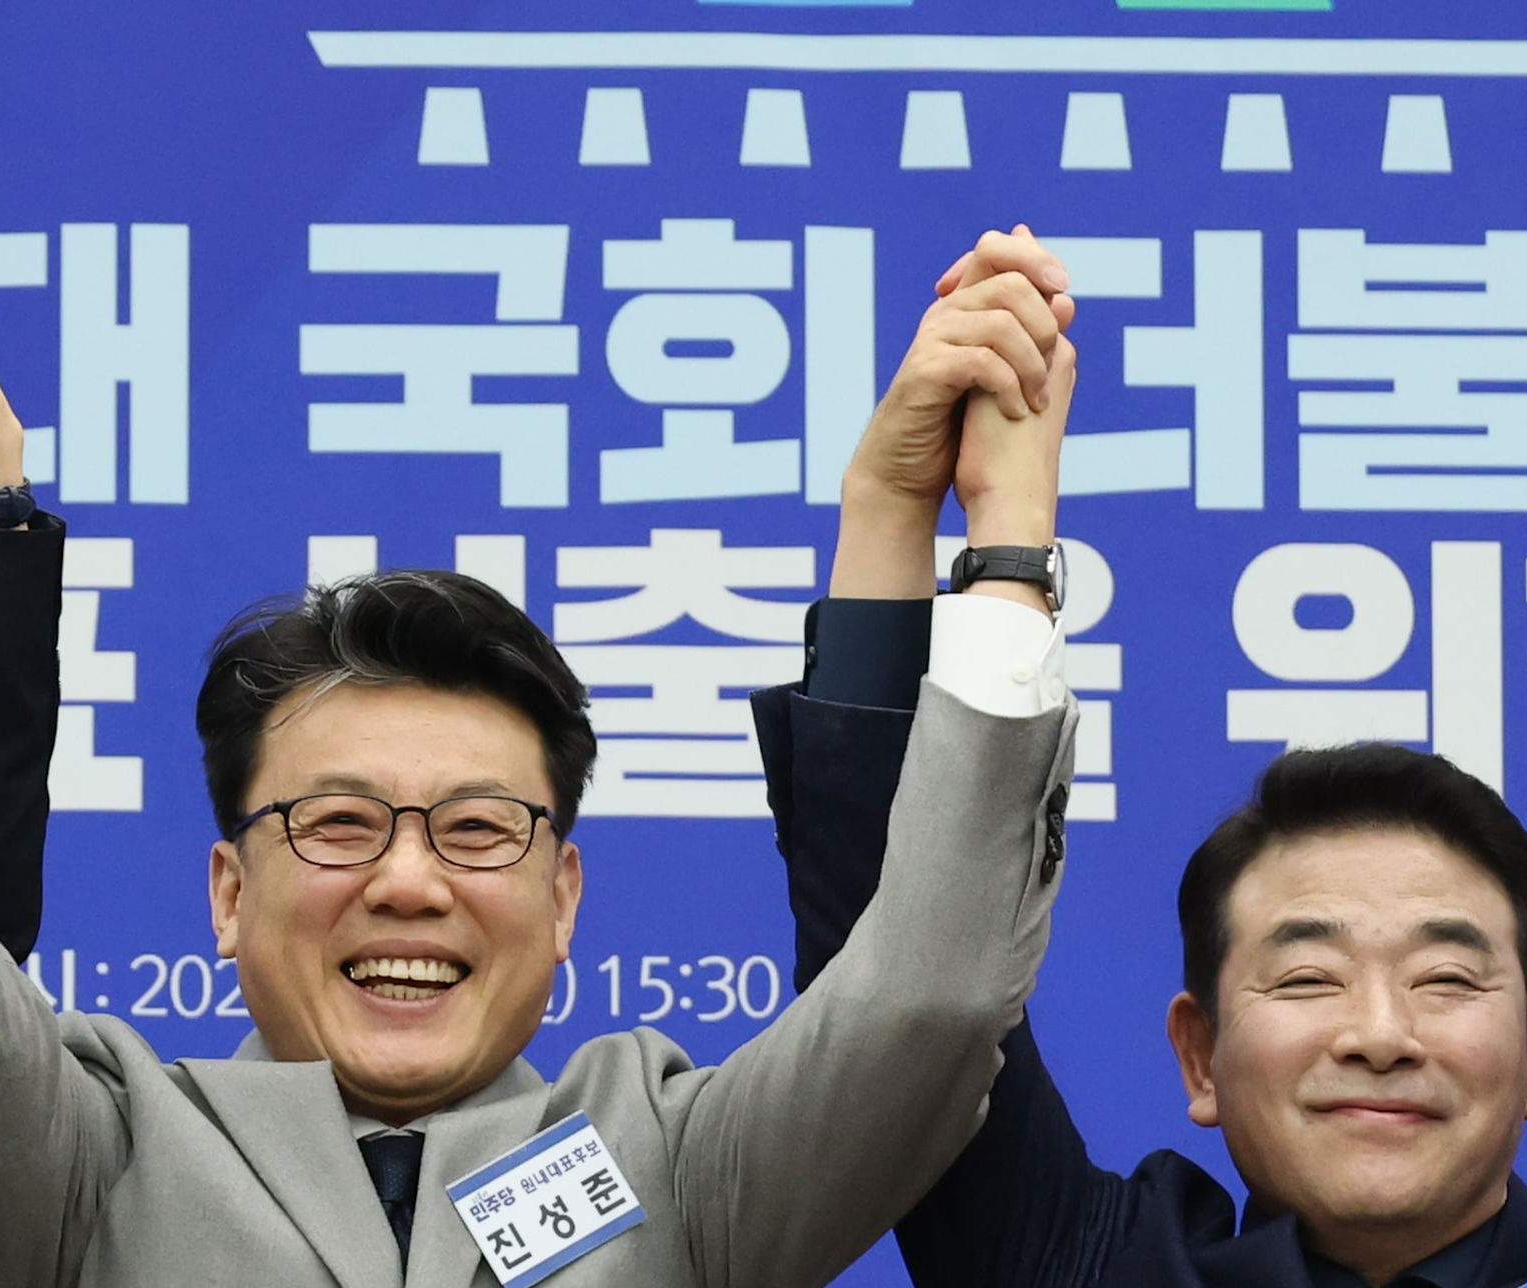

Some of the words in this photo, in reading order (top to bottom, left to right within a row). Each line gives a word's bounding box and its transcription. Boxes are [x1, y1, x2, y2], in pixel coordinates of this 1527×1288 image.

[299, 217, 875, 508] 국회
[597, 954, 780, 1022] 15:30
[469, 1186, 516, 1223] 민주당
[520, 1139, 602, 1195] 원내대표후보
